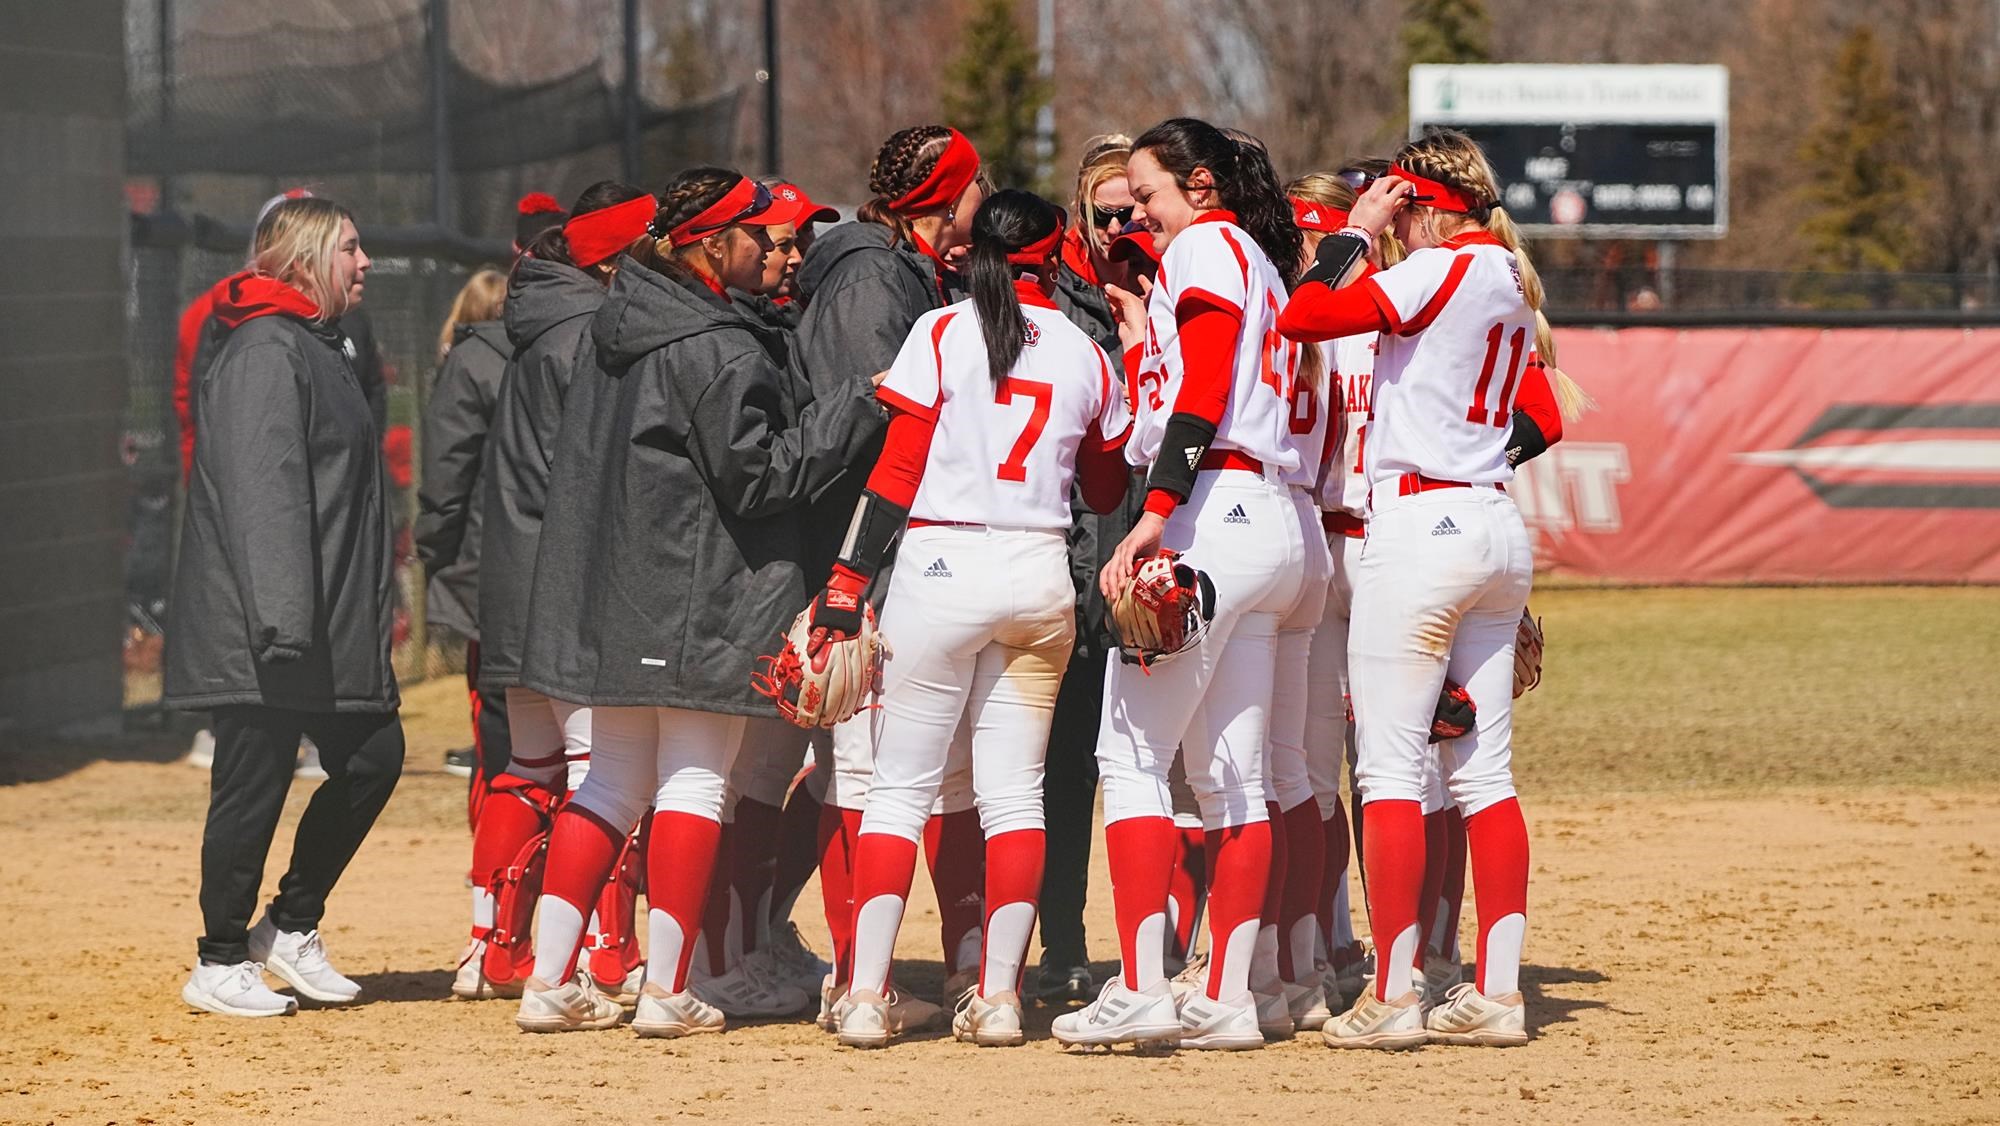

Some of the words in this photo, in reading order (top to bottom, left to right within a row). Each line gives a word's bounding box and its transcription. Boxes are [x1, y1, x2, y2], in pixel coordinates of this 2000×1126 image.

[1466, 322, 1525, 428] 11
[995, 376, 1053, 482] 7
[1189, 445, 1205, 470] adidas
[1223, 516, 1251, 525] adidas
[1431, 528, 1462, 536] adidas
[923, 569, 953, 578] adidas
